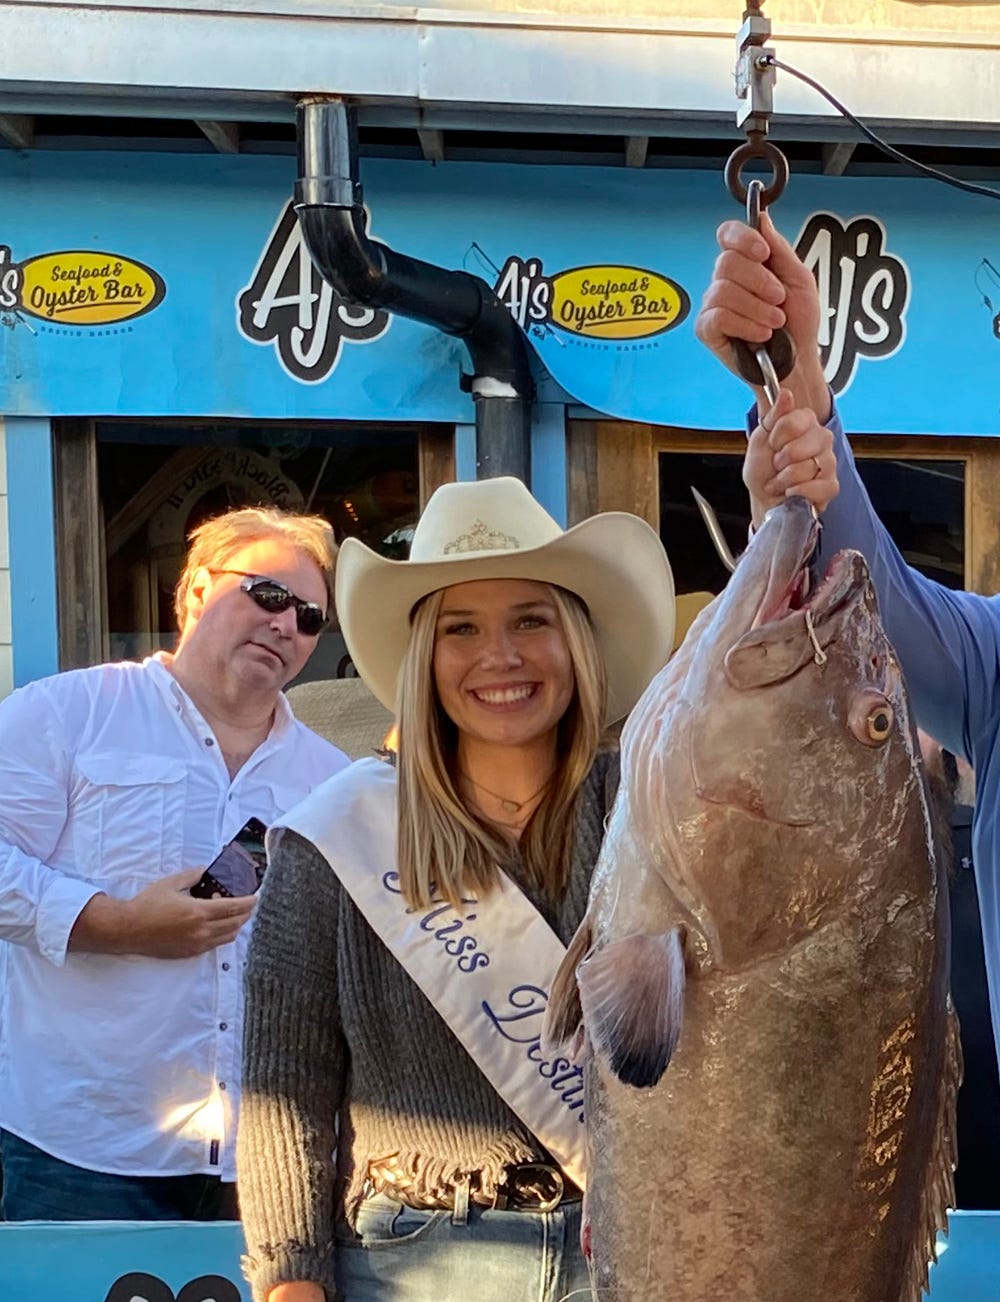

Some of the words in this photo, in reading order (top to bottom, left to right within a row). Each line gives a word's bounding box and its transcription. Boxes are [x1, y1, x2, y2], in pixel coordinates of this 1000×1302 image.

[51, 264, 111, 285] Seafood
[113, 262, 123, 277] &
[580, 279, 638, 300] Seafood
[640, 277, 650, 291] &
[31, 284, 98, 317] Oyster
[103, 279, 146, 300] Bar
[560, 298, 627, 331] Oyster
[631, 294, 672, 316] Bar
